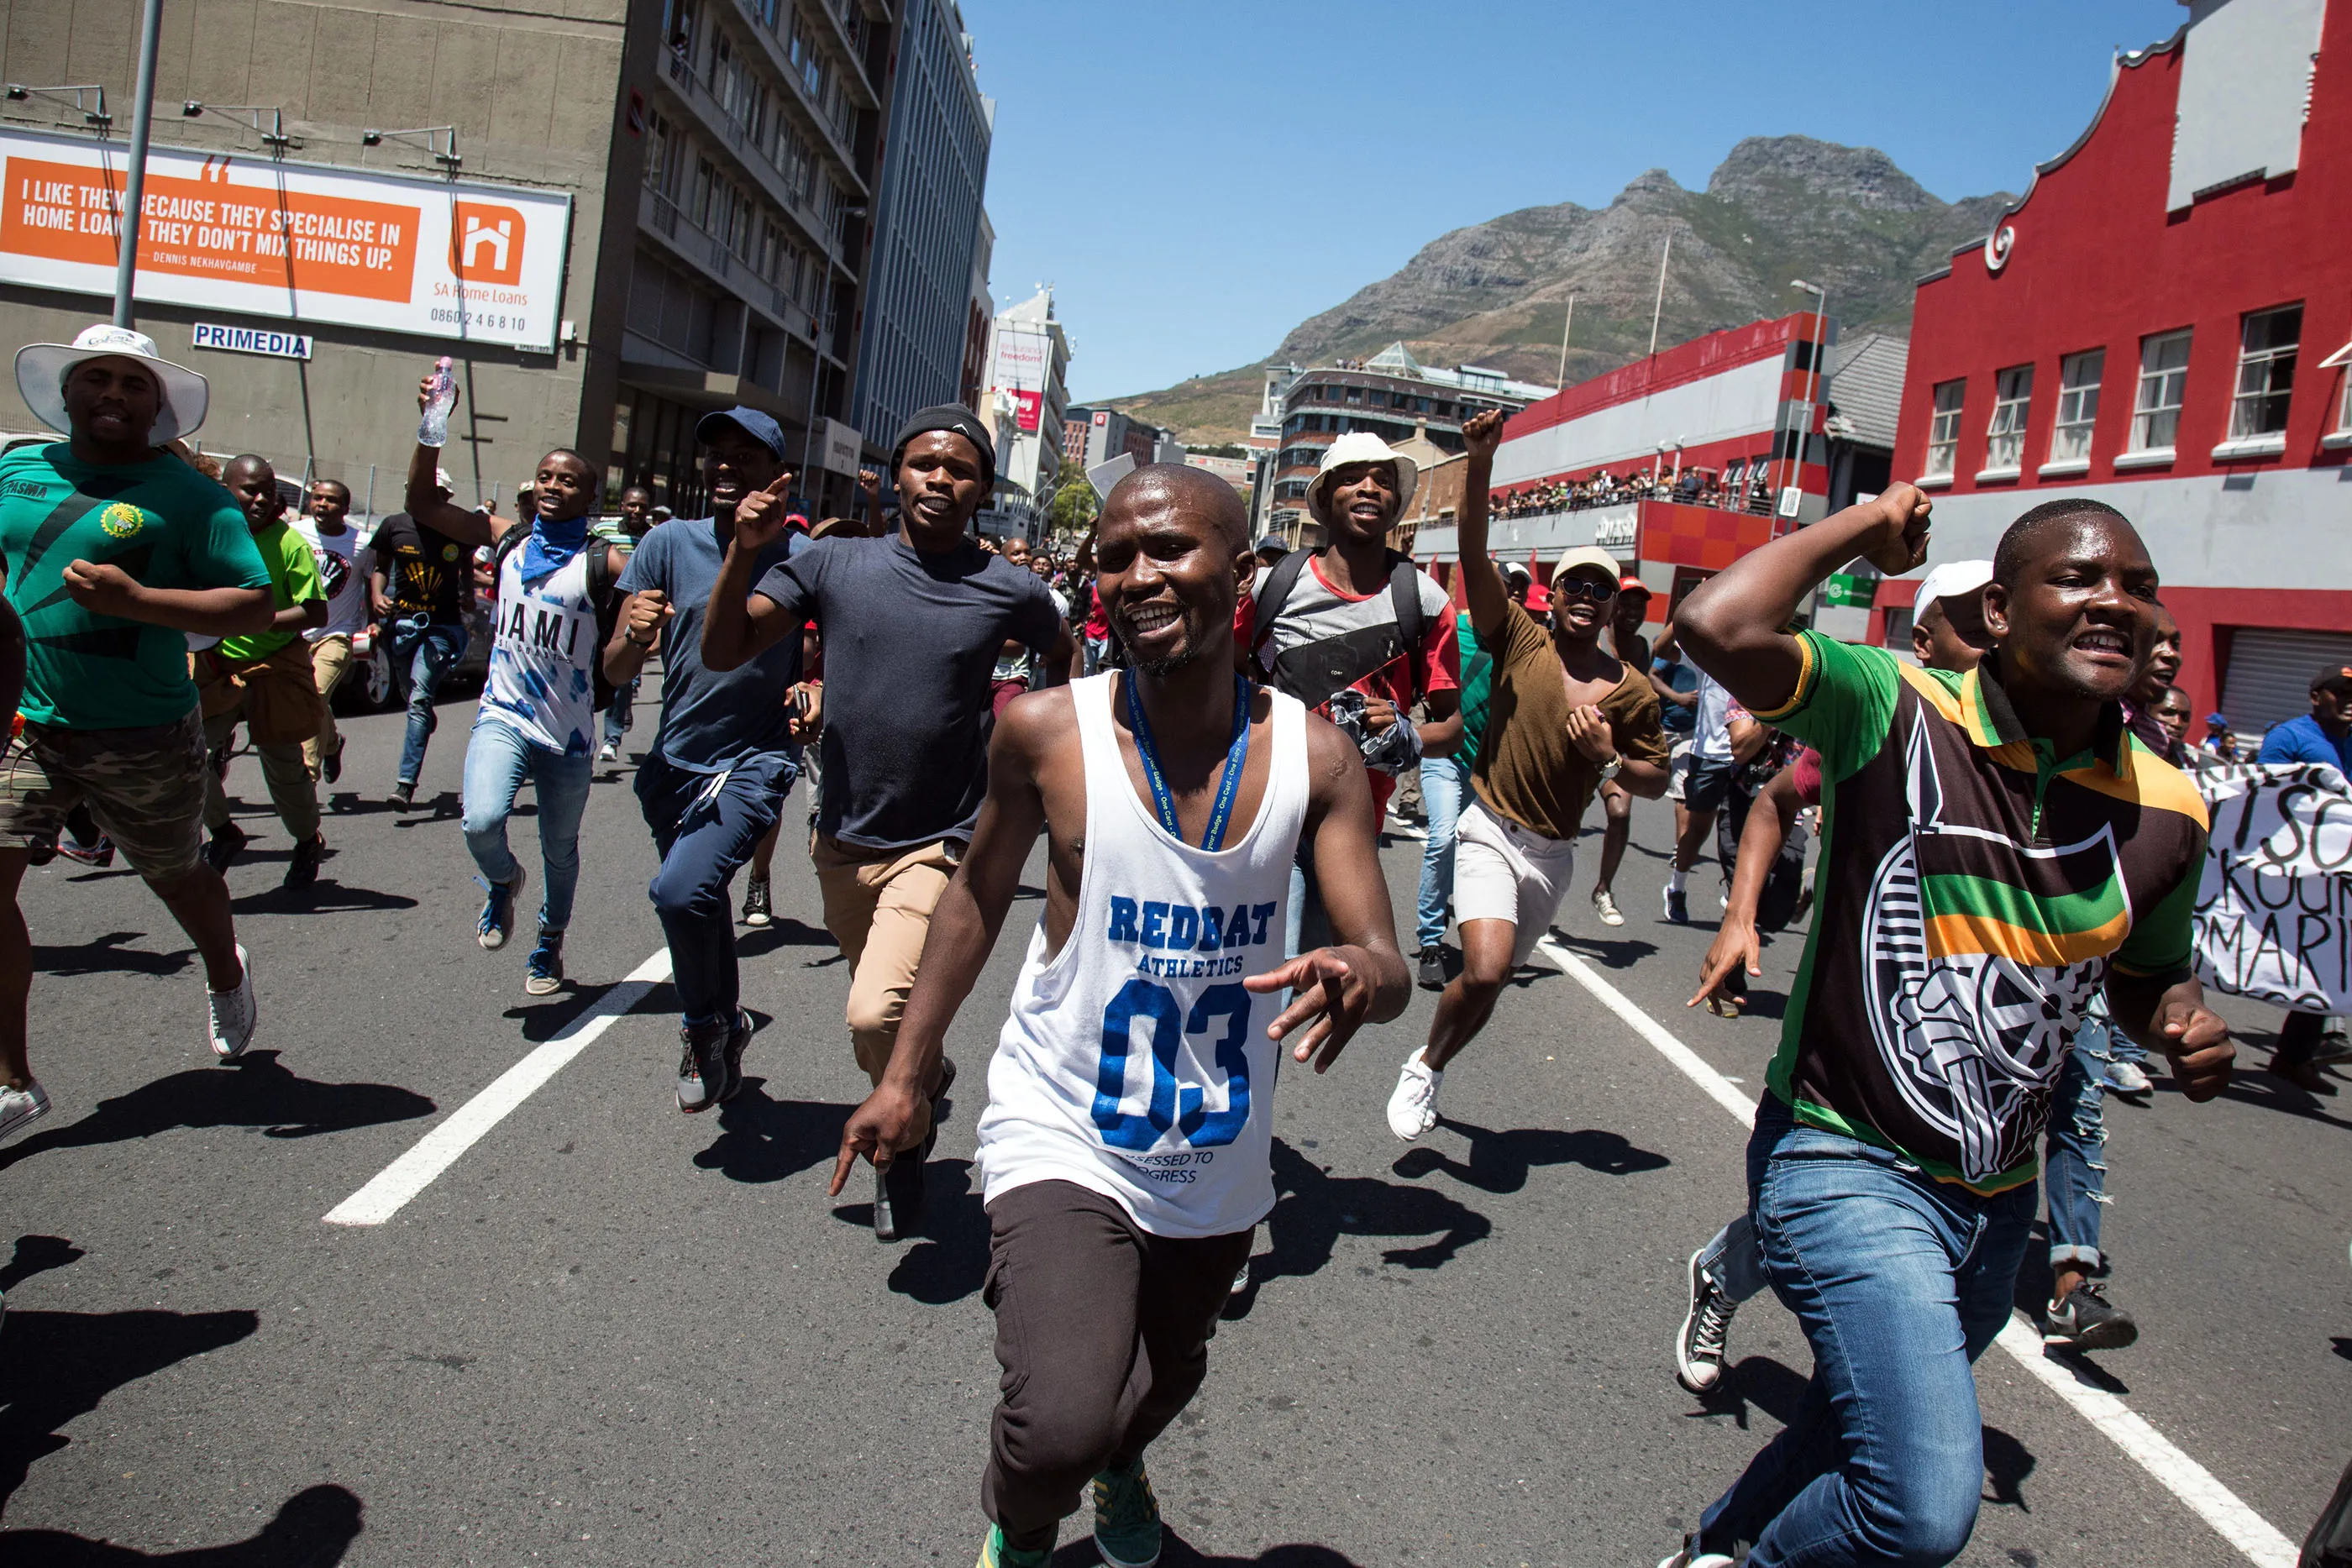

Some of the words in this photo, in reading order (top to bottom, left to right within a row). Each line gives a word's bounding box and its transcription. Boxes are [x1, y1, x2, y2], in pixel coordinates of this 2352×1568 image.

[23, 179, 29, 199] I
[34, 181, 74, 206] LIKE
[79, 186, 126, 212] THEM
[221, 203, 266, 228] THEY
[270, 209, 375, 243] SPECIALISE
[381, 223, 401, 246] IN
[24, 204, 75, 231] HOME
[148, 220, 194, 246] THEY
[197, 226, 252, 253] DON'T
[255, 232, 290, 258] MIX
[295, 238, 361, 266] THINGS
[365, 247, 393, 270] UP.
[153, 251, 187, 266] DENNIS
[433, 282, 449, 296] SA
[453, 284, 489, 302] Home
[492, 290, 528, 306] Loans
[431, 308, 461, 323] 0860
[512, 317, 525, 331] 10
[195, 325, 307, 356] PRIMEDIA
[7, 481, 47, 498] PASMA
[499, 598, 580, 656] IAMI
[1231, 747, 1242, 763] Entry
[1228, 763, 1236, 775] One
[1151, 770, 1163, 791] Badge
[1222, 779, 1231, 795] Card
[1160, 795, 1169, 810] One
[1218, 795, 1226, 809] One
[1163, 810, 1173, 826] Card
[1210, 814, 1222, 835] Badge
[1206, 834, 1215, 850] your
[1108, 895, 1277, 952] REDBAT
[1137, 954, 1243, 978] ATHLETICS
[1091, 978, 1252, 1151] 03
[1194, 1151, 1214, 1164] TO
